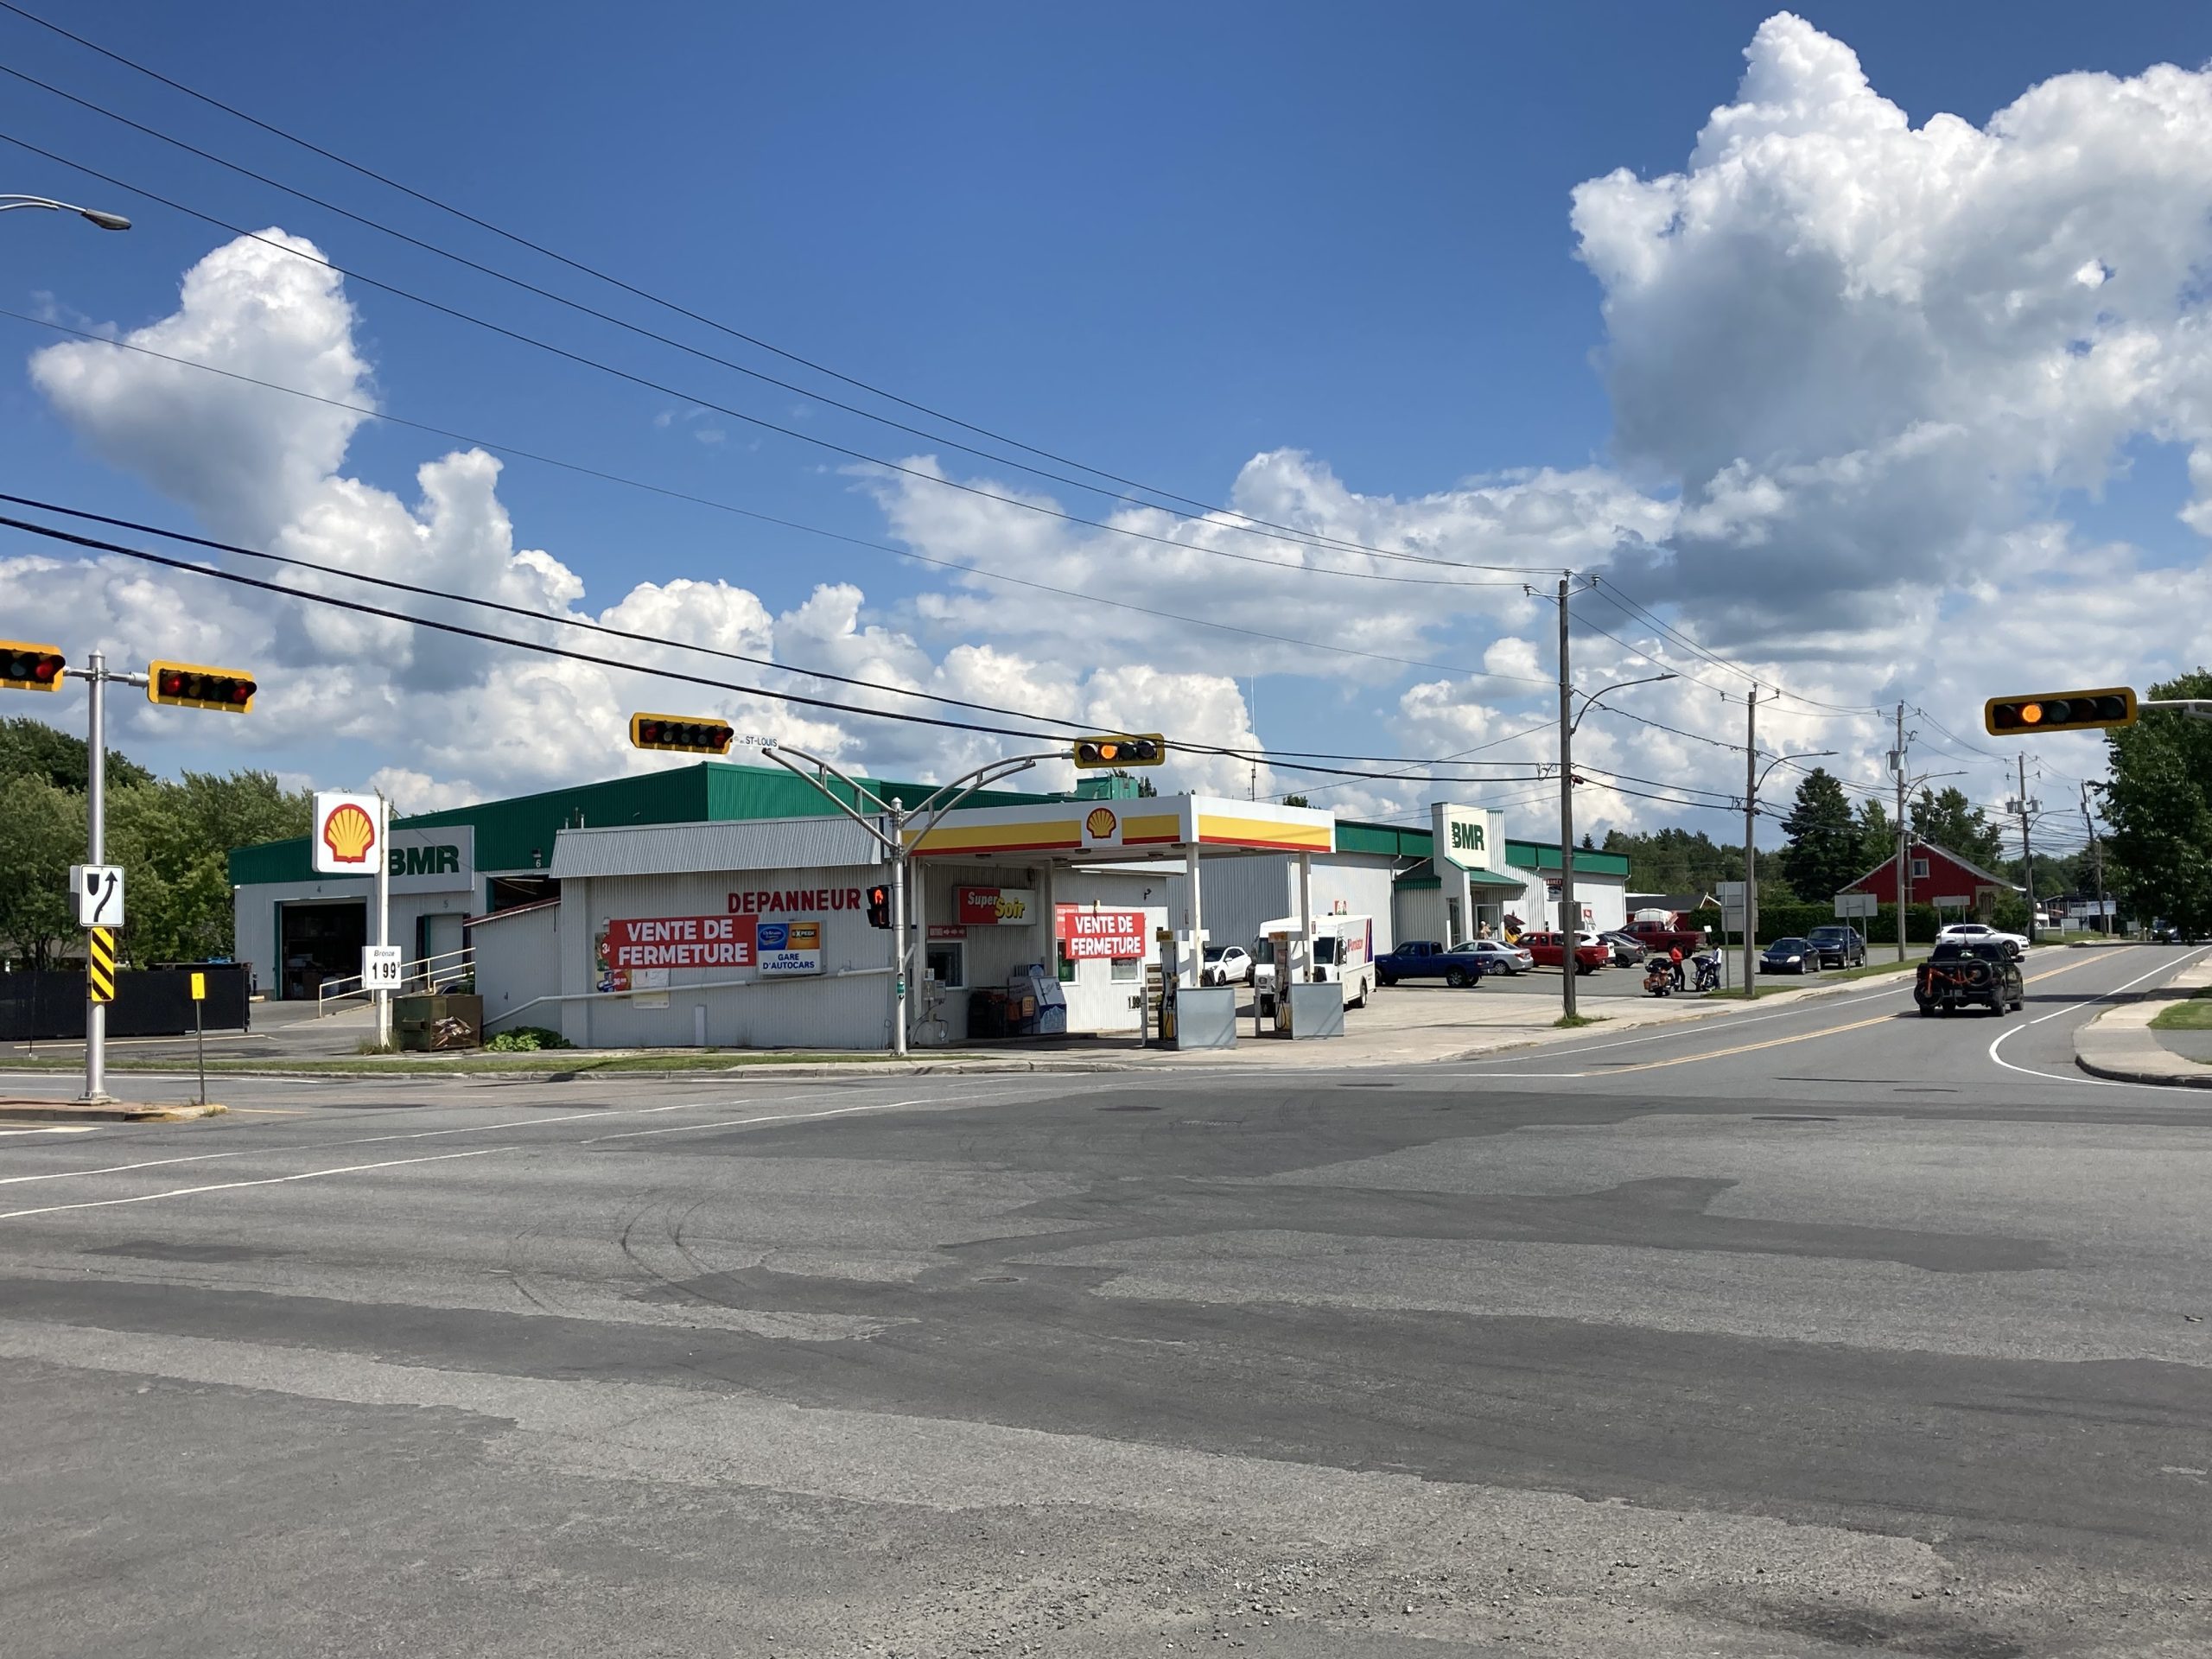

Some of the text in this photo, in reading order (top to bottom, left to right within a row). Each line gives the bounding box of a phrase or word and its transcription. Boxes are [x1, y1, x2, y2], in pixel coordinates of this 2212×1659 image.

[745, 735, 777, 747] ST-LOUIS
[1451, 821, 1485, 851] BMR
[388, 844, 460, 876] BMR
[536, 859, 541, 868] 6
[728, 888, 861, 913] DEPANNEUR
[968, 891, 1026, 918] Super Soir
[626, 918, 734, 942] VENTE DE
[1074, 915, 1134, 934] VENTE DE
[618, 943, 749, 965] FERMETURE
[1071, 936, 1141, 956] FERMETURE
[762, 961, 815, 969] D'AUTOCARS
